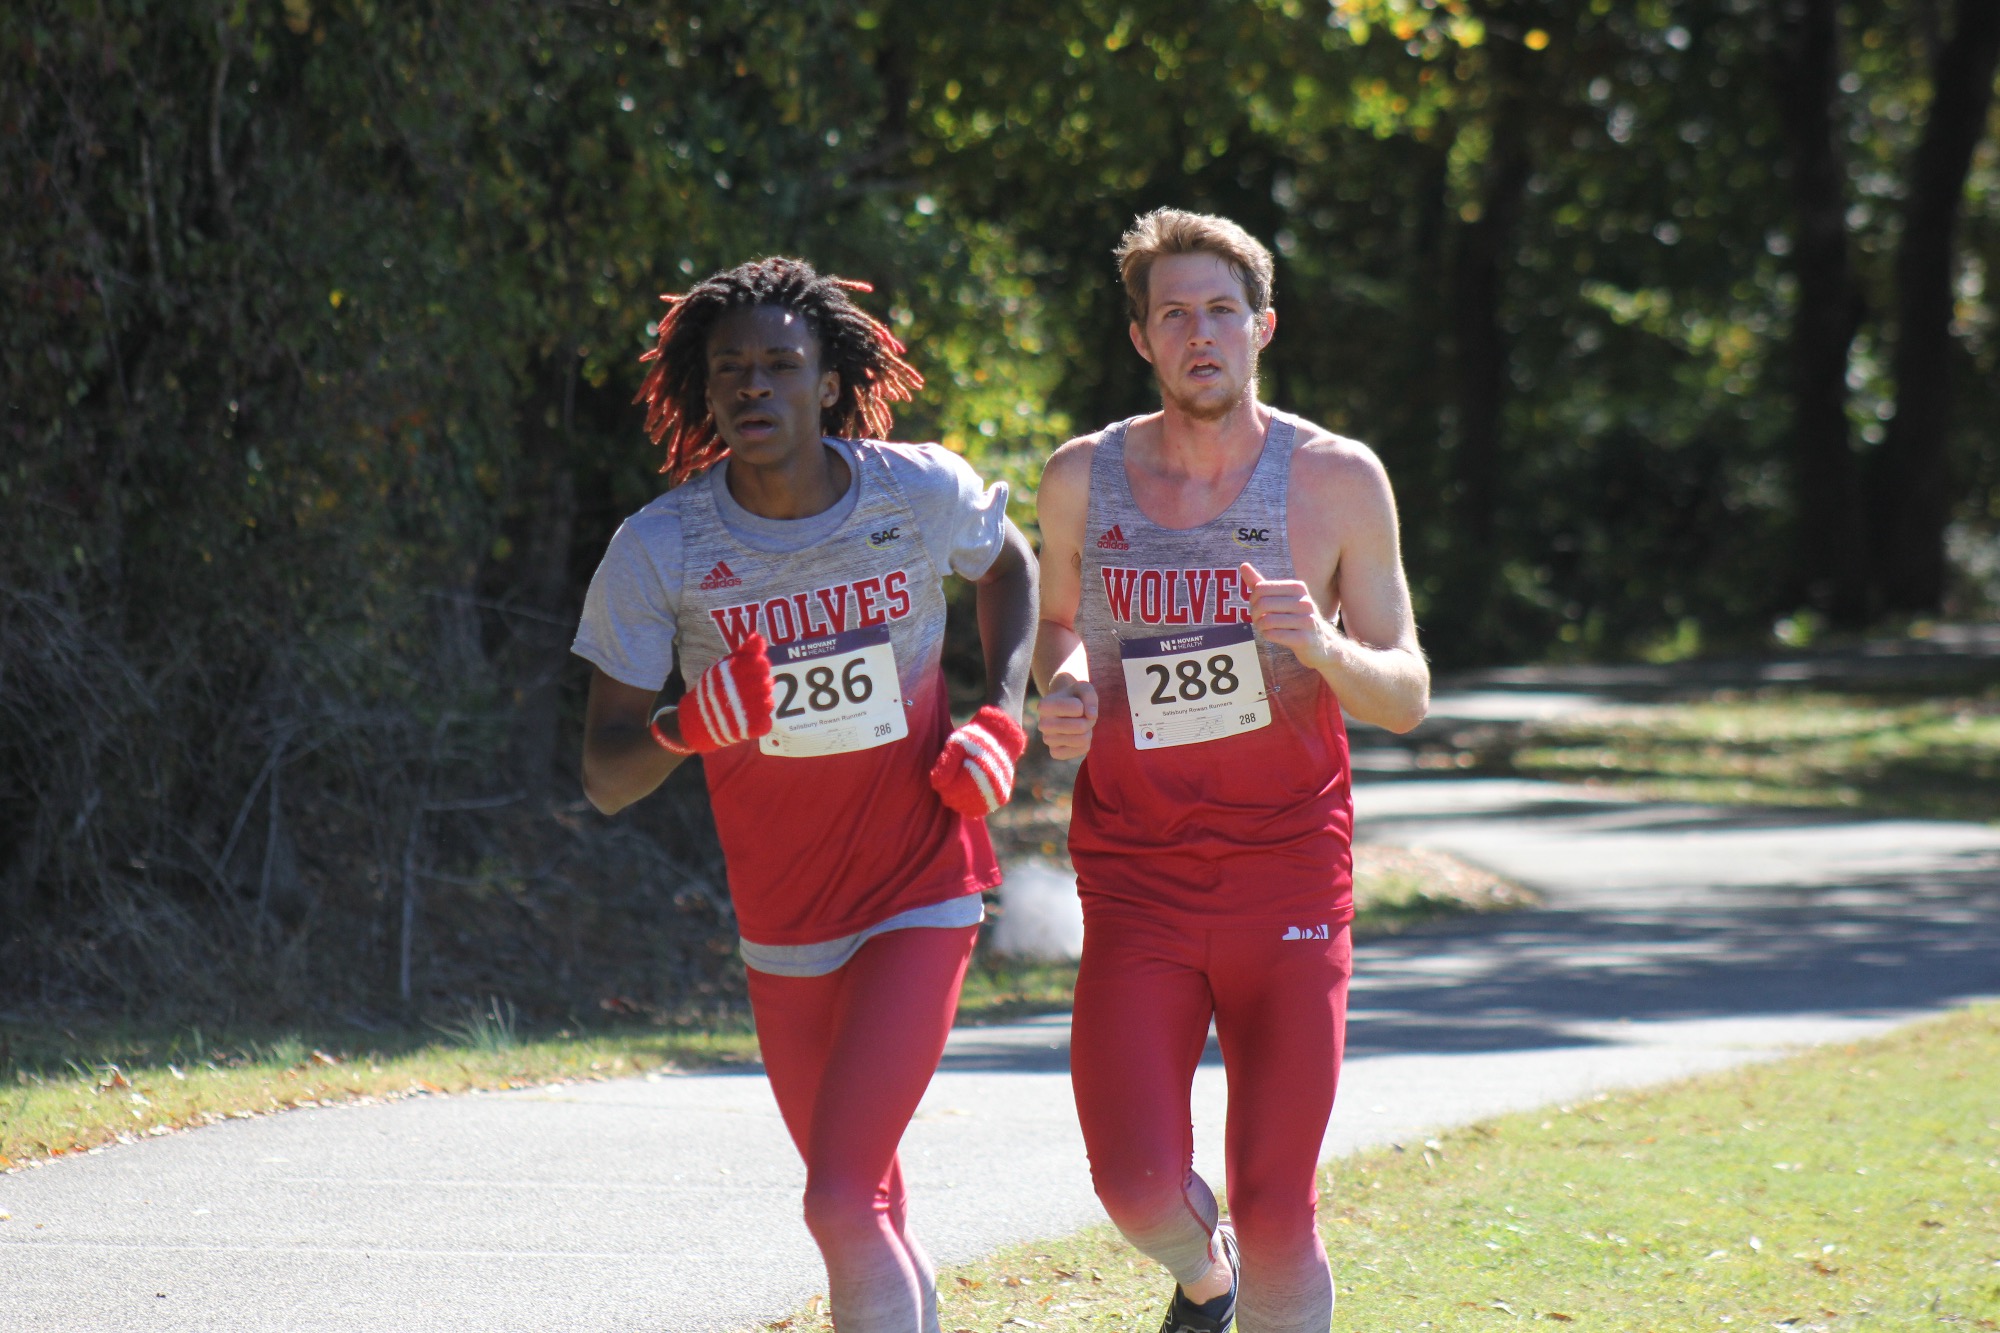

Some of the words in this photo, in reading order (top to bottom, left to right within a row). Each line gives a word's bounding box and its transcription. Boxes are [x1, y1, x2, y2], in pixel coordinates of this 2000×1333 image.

[870, 527, 900, 545] SAC
[1237, 527, 1269, 542] SAC
[1097, 539, 1130, 551] adidas
[701, 575, 742, 590] adidas
[709, 569, 912, 653] WOLVES
[807, 638, 837, 649] NOVANT
[1177, 635, 1204, 644] NOVANT
[1177, 640, 1203, 650] HEALTH
[808, 645, 836, 656] HEALTH
[1145, 654, 1239, 705] 288
[774, 657, 873, 720] 286
[1162, 708, 1188, 717] Salisbury
[1188, 705, 1208, 714] Rowan
[1208, 701, 1233, 710] Runners
[788, 721, 818, 732] Salisbury
[818, 716, 841, 726] Rowan
[841, 710, 867, 721] Runners
[1238, 712, 1257, 726] 288
[873, 722, 892, 738] 286
